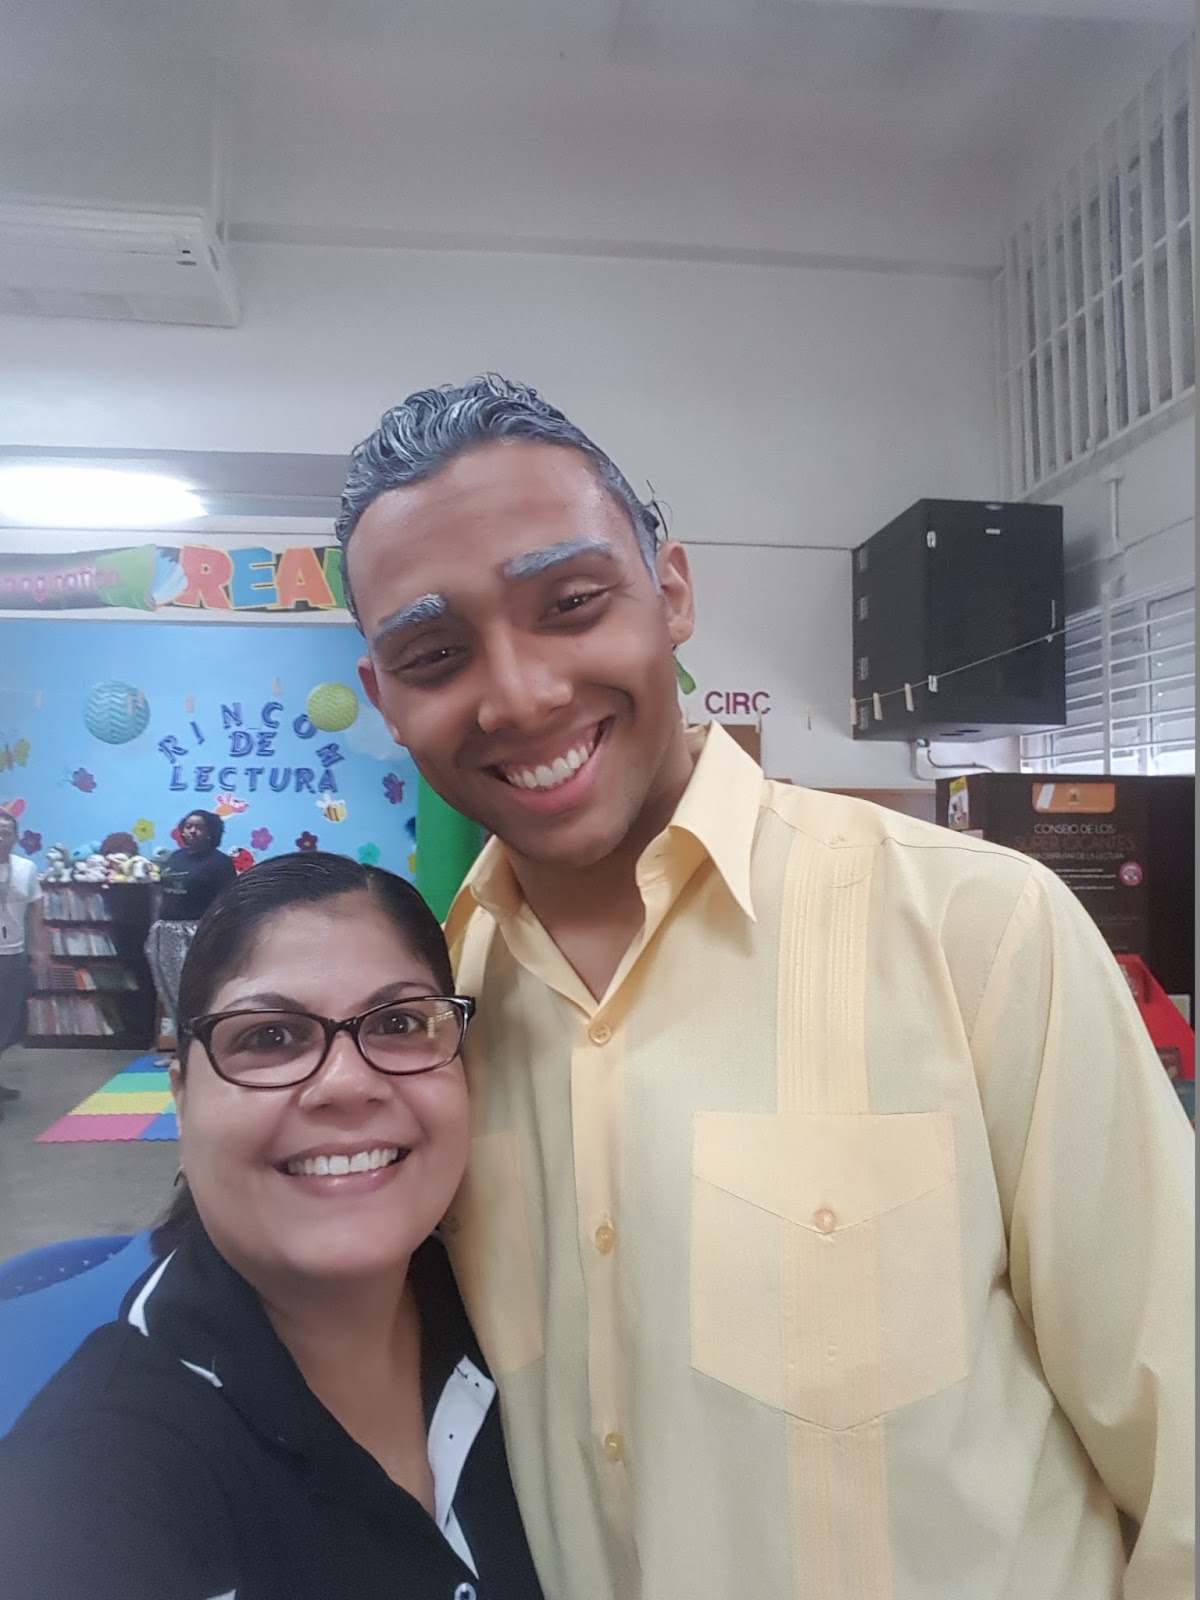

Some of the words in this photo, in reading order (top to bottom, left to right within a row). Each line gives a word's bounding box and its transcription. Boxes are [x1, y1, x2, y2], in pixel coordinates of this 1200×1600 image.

[705, 691, 771, 715] CIRC
[229, 730, 278, 758] DE
[169, 765, 339, 794] LECTURA
